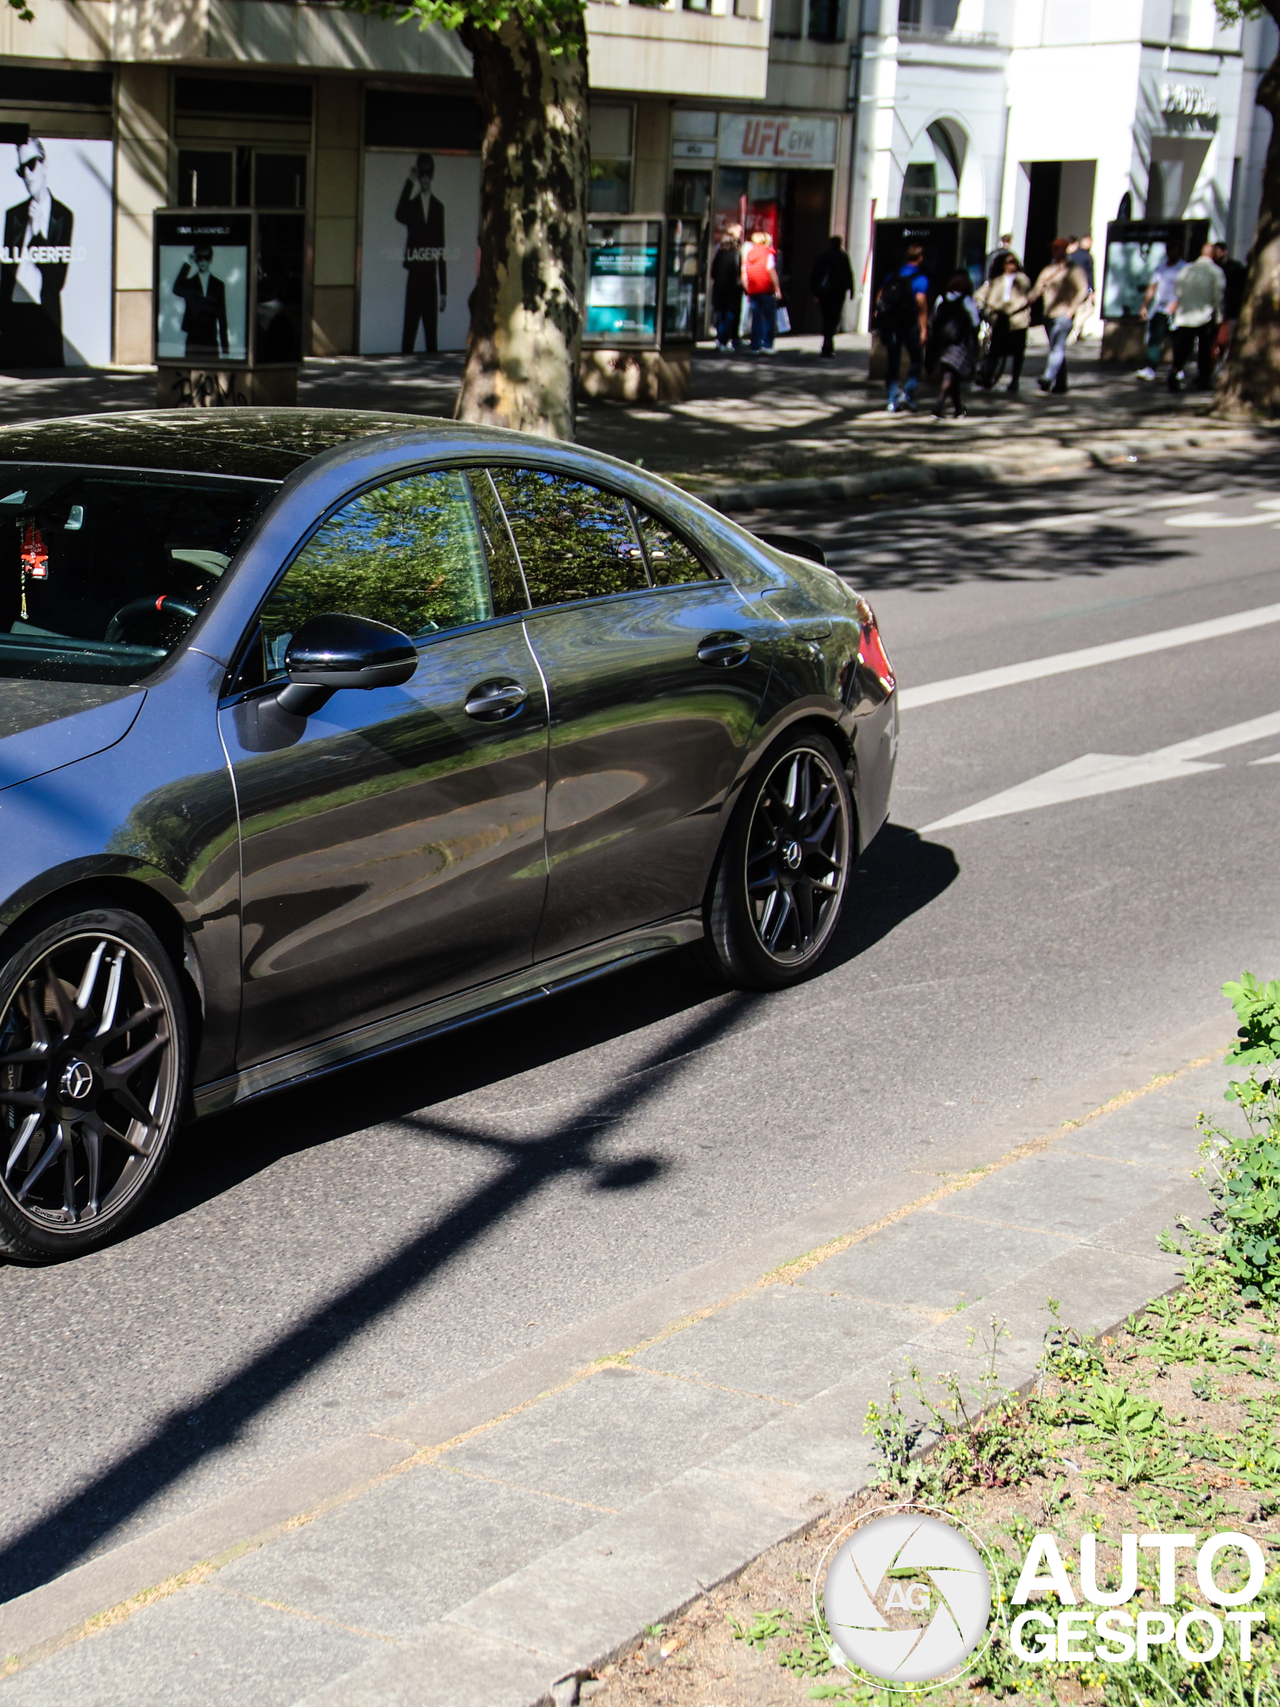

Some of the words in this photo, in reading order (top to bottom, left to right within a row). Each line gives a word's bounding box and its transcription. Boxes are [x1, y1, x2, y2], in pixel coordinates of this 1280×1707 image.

[741, 119, 790, 156] UFC
[788, 130, 815, 150] GYM
[13, 246, 86, 264] LAGERFELD
